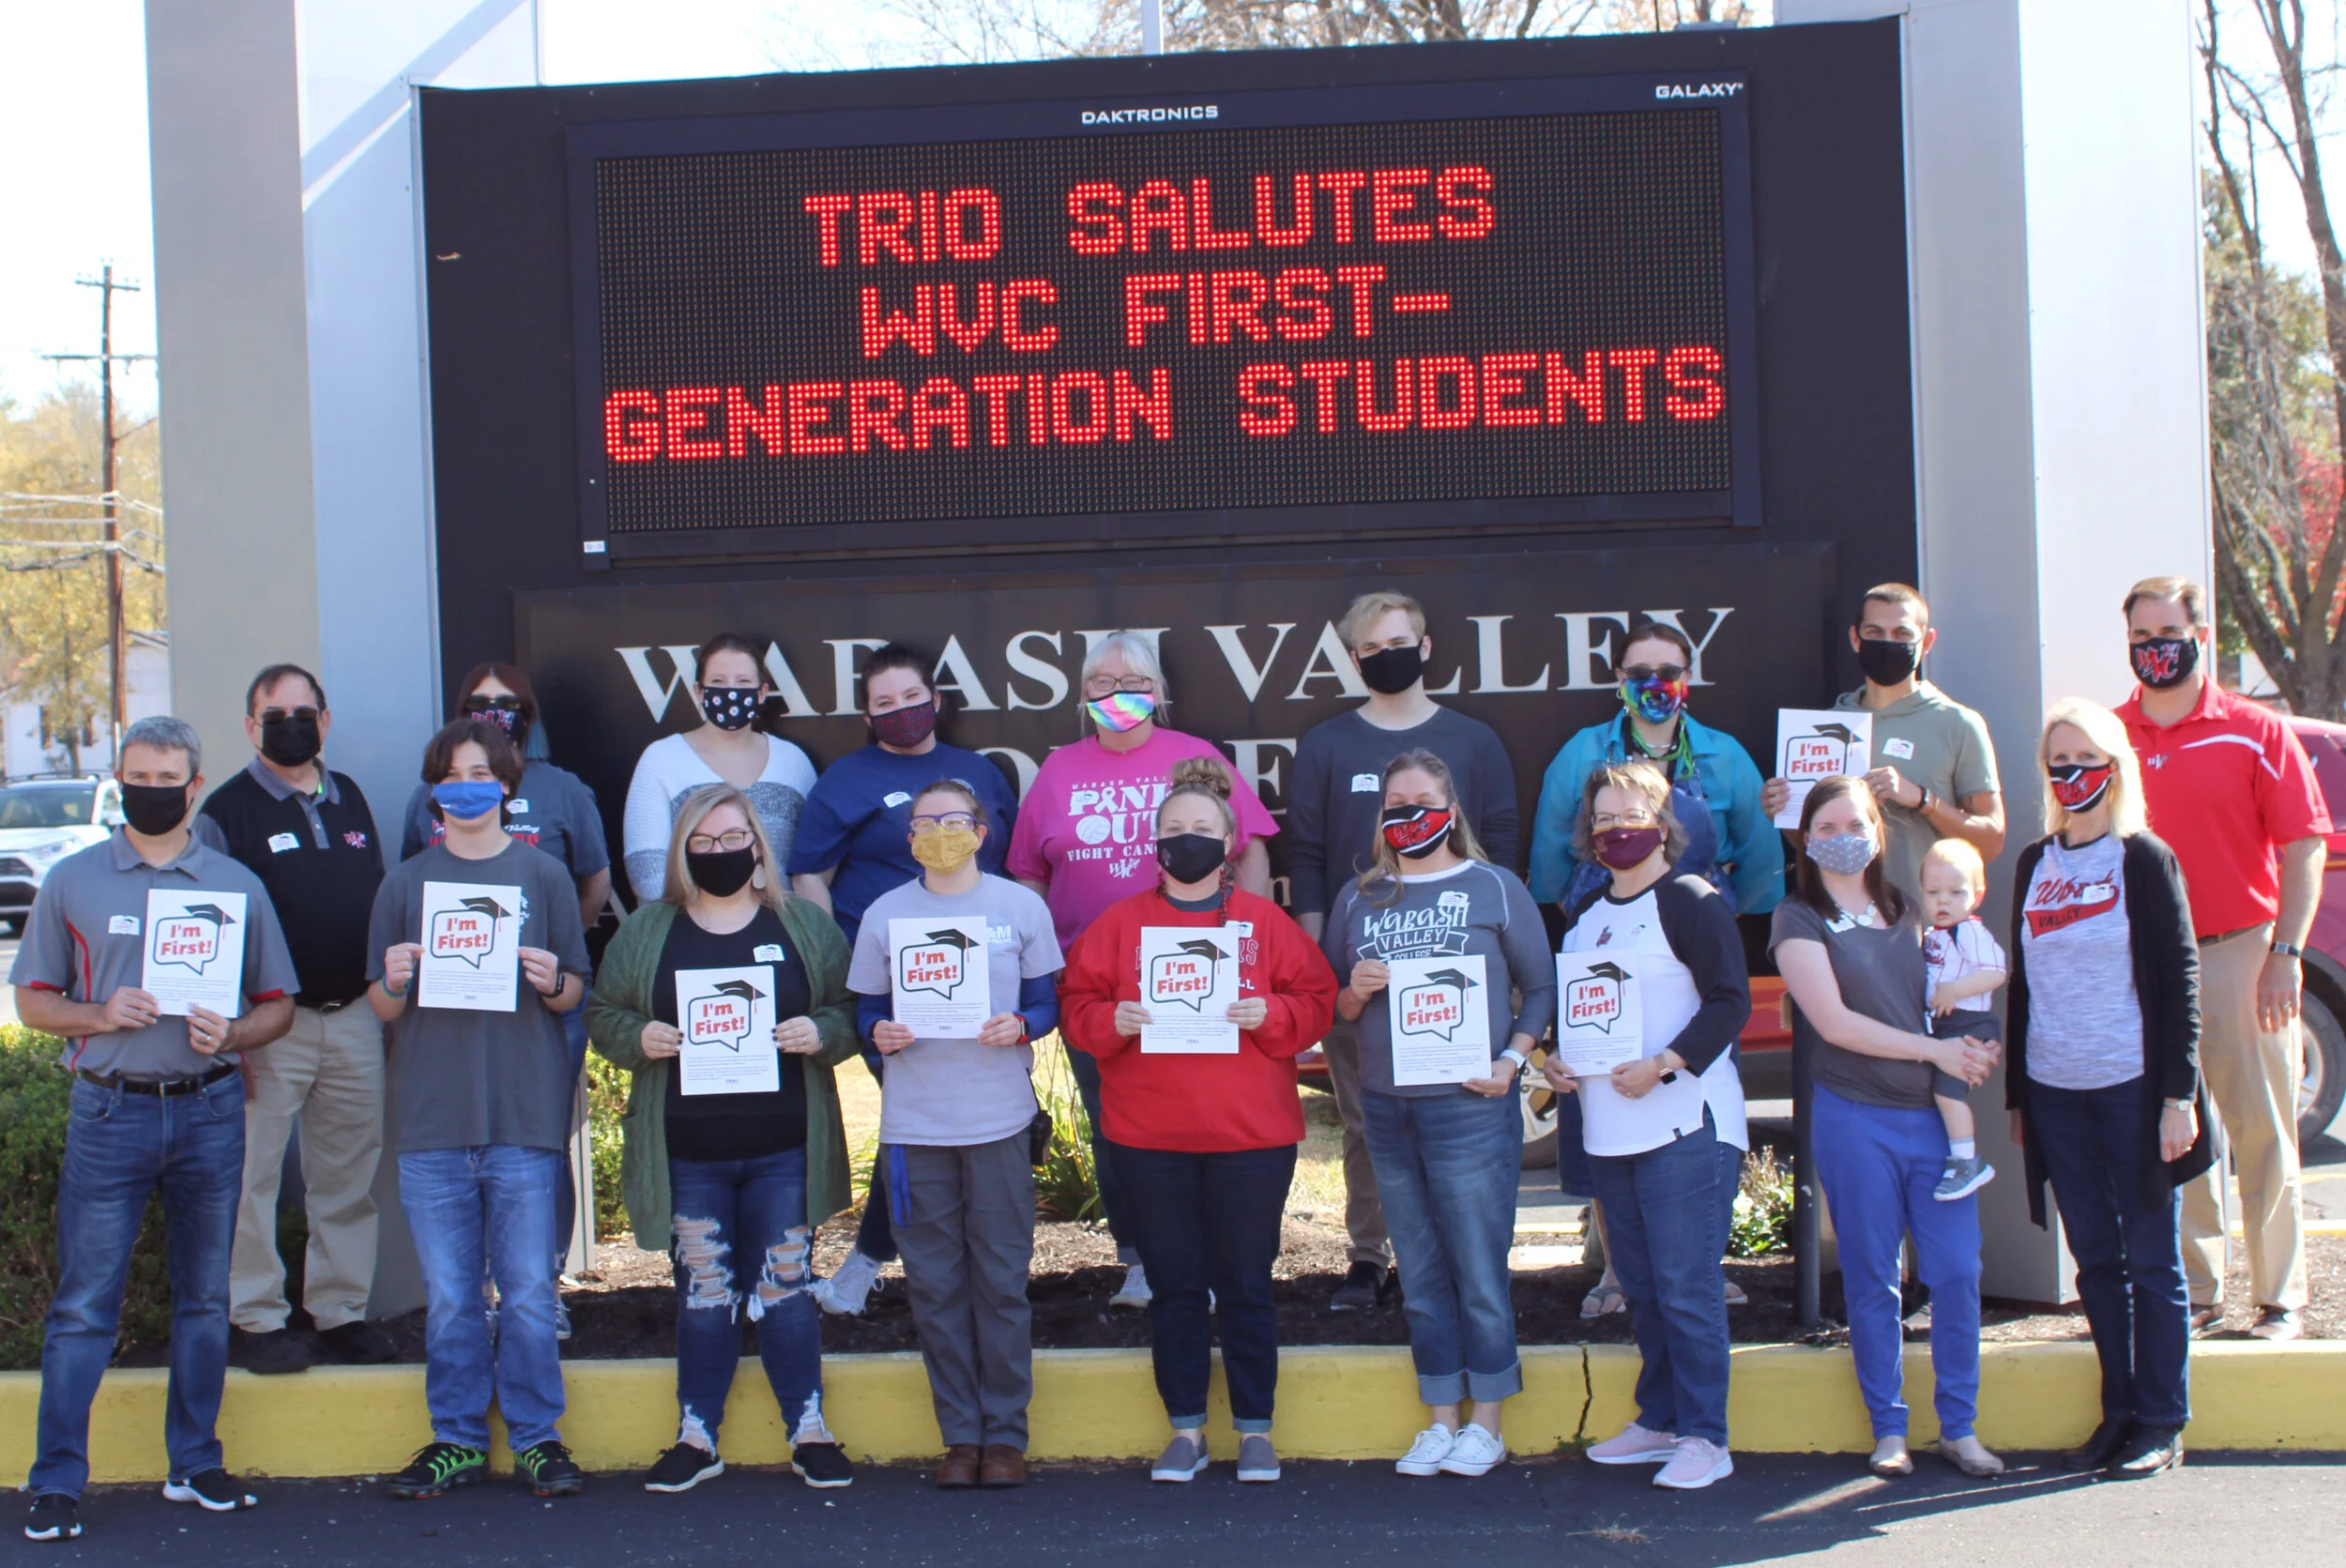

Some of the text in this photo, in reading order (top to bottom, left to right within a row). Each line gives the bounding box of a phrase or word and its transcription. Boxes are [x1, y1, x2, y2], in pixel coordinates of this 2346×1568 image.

[1081, 105, 1219, 125] DAKTRONICS
[802, 165, 1495, 266] TRIO SALUTES
[861, 264, 1450, 358] WVC FIRST-
[603, 344, 1724, 463] GENERATION STUDENTS
[1801, 745, 1829, 756] I'm
[1791, 759, 1840, 773] First!
[1066, 847, 1114, 861] FIGHT
[172, 925, 201, 937] I'm
[447, 918, 477, 931] I'm
[438, 935, 488, 949] First!
[1379, 928, 1446, 951] VALLEY
[161, 940, 212, 955] First!
[916, 951, 945, 966] I'm
[907, 966, 957, 983] First!
[1166, 962, 1196, 976] I'm
[1157, 976, 1207, 994] First!
[1579, 985, 1605, 999] I'm
[1414, 993, 1445, 1008] I'm
[1573, 997, 1615, 1018] First!
[703, 1003, 733, 1017] I'm
[1407, 1005, 1456, 1026] First!
[695, 1016, 744, 1035] First!
